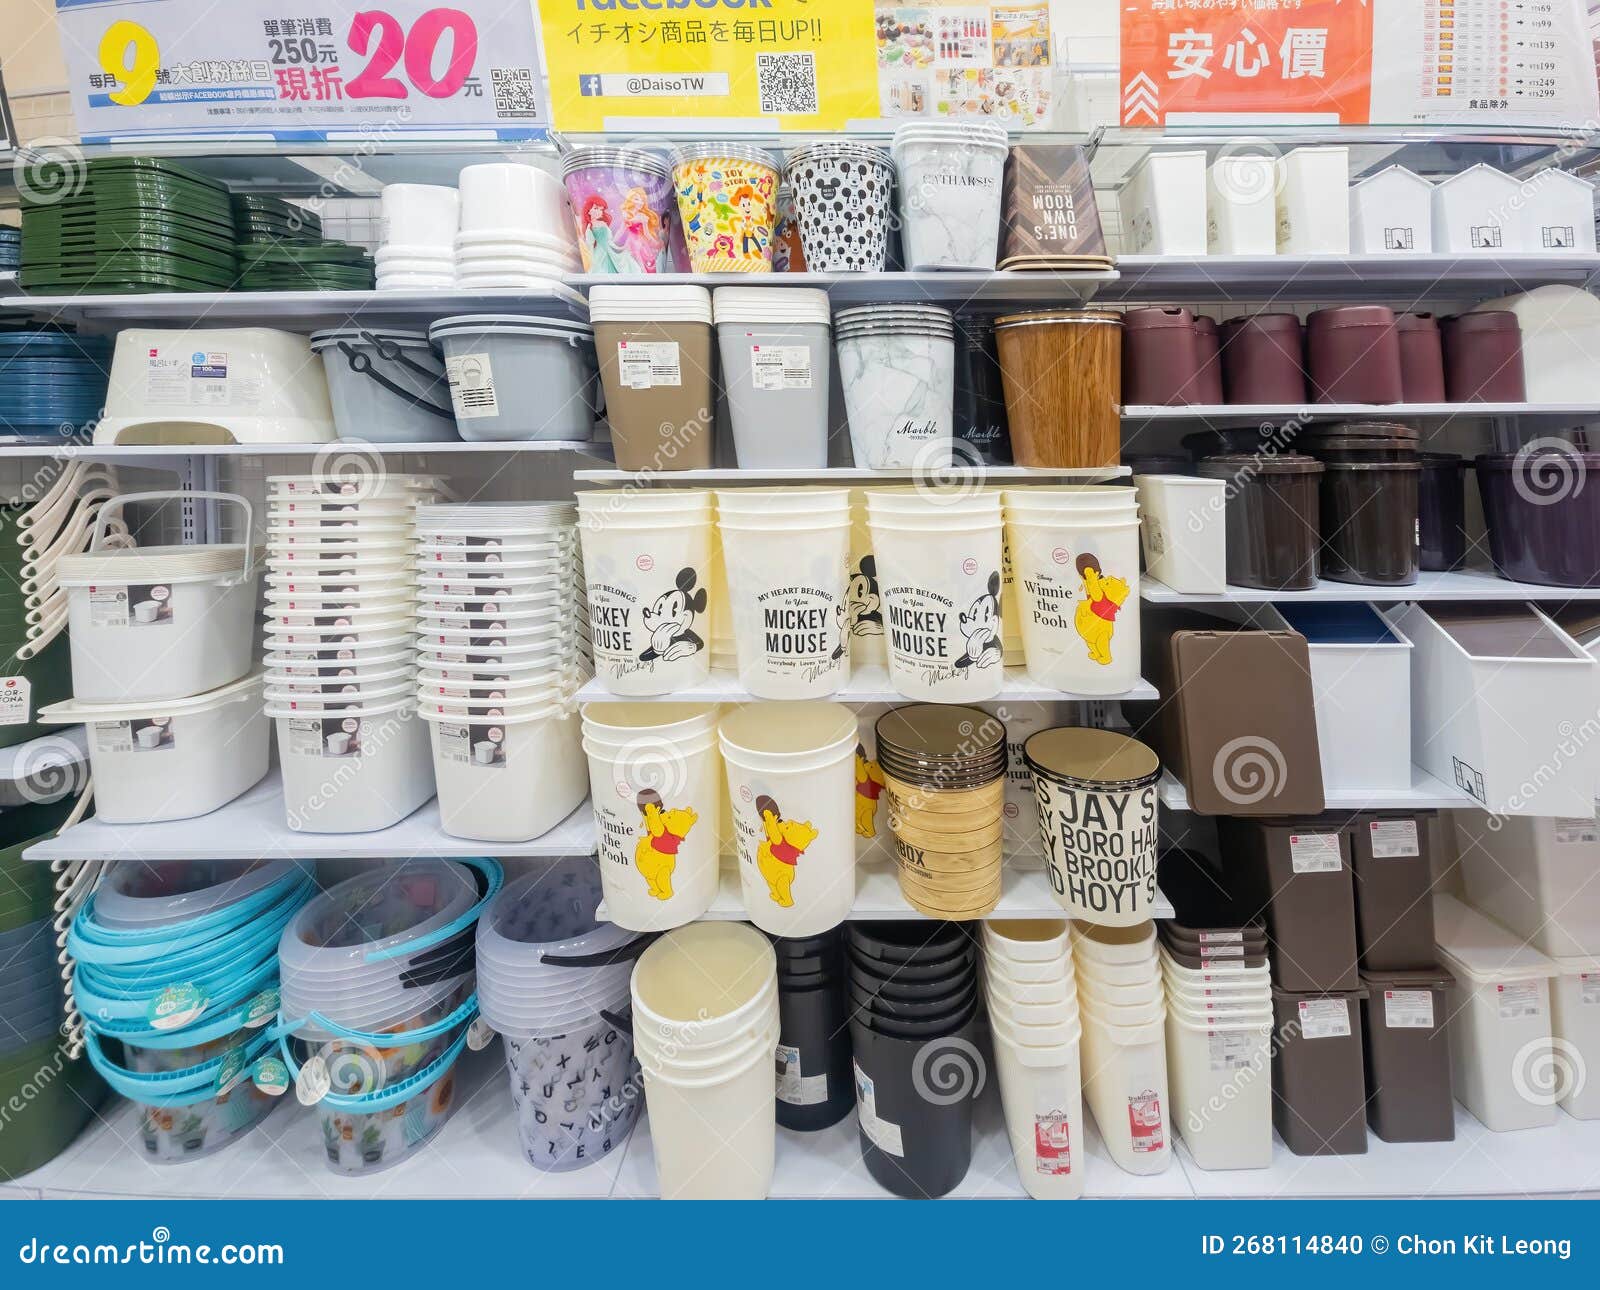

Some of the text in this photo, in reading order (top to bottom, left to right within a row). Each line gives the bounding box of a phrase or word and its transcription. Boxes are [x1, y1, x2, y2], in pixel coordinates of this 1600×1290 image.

[264, 18, 333, 37] 單筆消費
[567, 18, 822, 44] イチオシ商品を毎日UP!!
[268, 38, 338, 65] 250元
[274, 8, 483, 101] 現折 20 元
[1167, 27, 1328, 79] 安心價
[626, 77, 704, 94] @DaisoTW
[1469, 100, 1510, 109] 食品除外
[724, 169, 743, 178] TOY
[724, 179, 748, 187] STORY
[923, 175, 994, 187] CATHARSIS
[1033, 195, 1073, 209] ROOM
[1043, 211, 1075, 224] OWN
[1034, 226, 1077, 240] ONE'S
[897, 420, 937, 434] Marble
[962, 425, 1001, 439] Marble
[603, 585, 638, 603] BELONGS
[757, 587, 833, 602] MY HEART BELONGS
[892, 586, 914, 595] HEART
[916, 588, 954, 608] BELONGS
[1024, 580, 1073, 599] Winnie
[1037, 598, 1058, 612] the
[765, 608, 827, 629] MICKEY
[889, 604, 946, 633] MICKEY
[1033, 610, 1067, 628] Pooh
[766, 632, 827, 653] MOUSE
[891, 628, 948, 657] MOUSE
[1058, 786, 1130, 830] JAY
[595, 809, 634, 836] Winnie
[603, 833, 621, 849] the
[1060, 822, 1124, 857] BORO
[602, 843, 628, 866] Pooh
[1065, 848, 1157, 882] BROOKLY
[1068, 874, 1140, 914] HOYT
